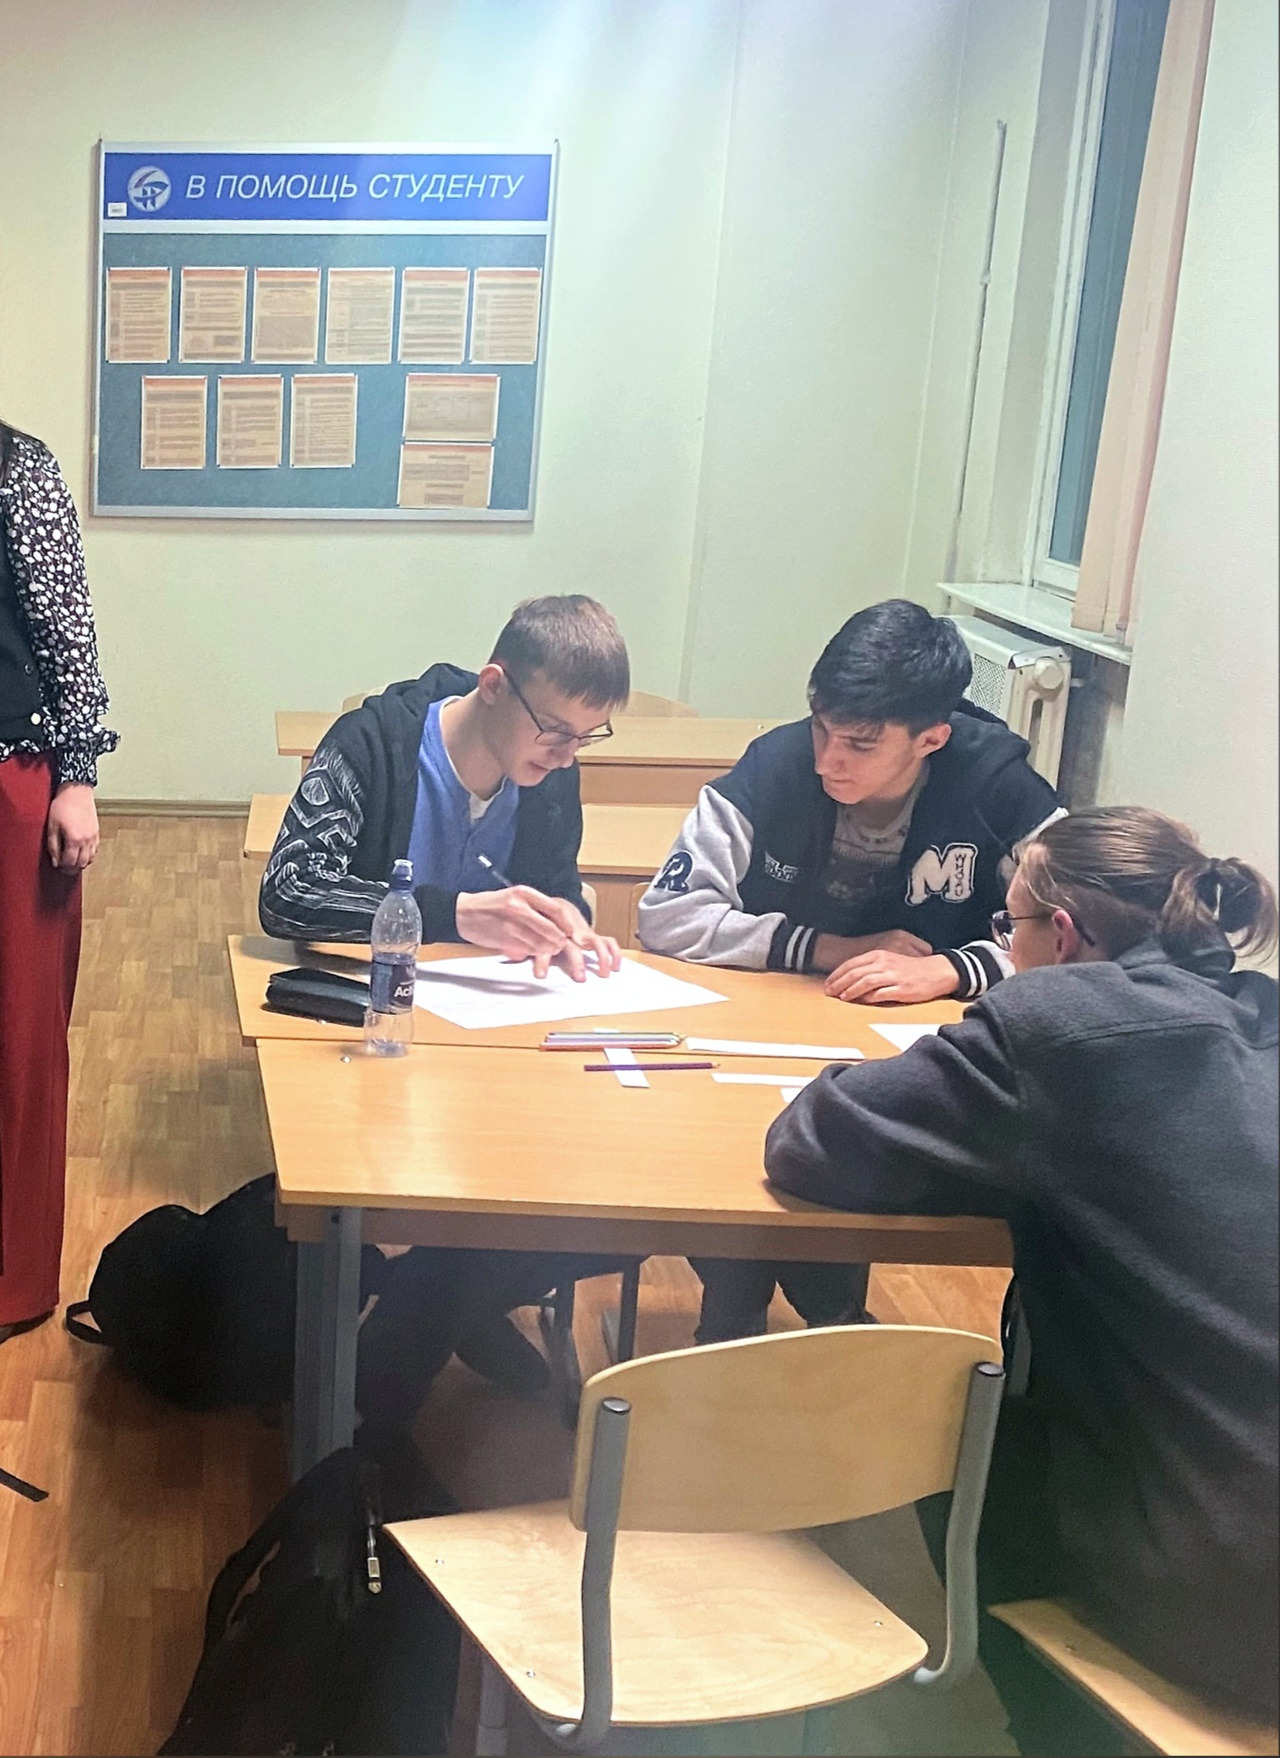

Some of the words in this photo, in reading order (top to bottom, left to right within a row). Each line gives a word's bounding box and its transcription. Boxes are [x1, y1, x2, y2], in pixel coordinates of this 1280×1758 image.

[186, 174, 205, 199] В
[216, 174, 358, 203] ПОМОЩЬ
[368, 173, 525, 203] СТУДЕНТУ
[904, 842, 979, 907] M
